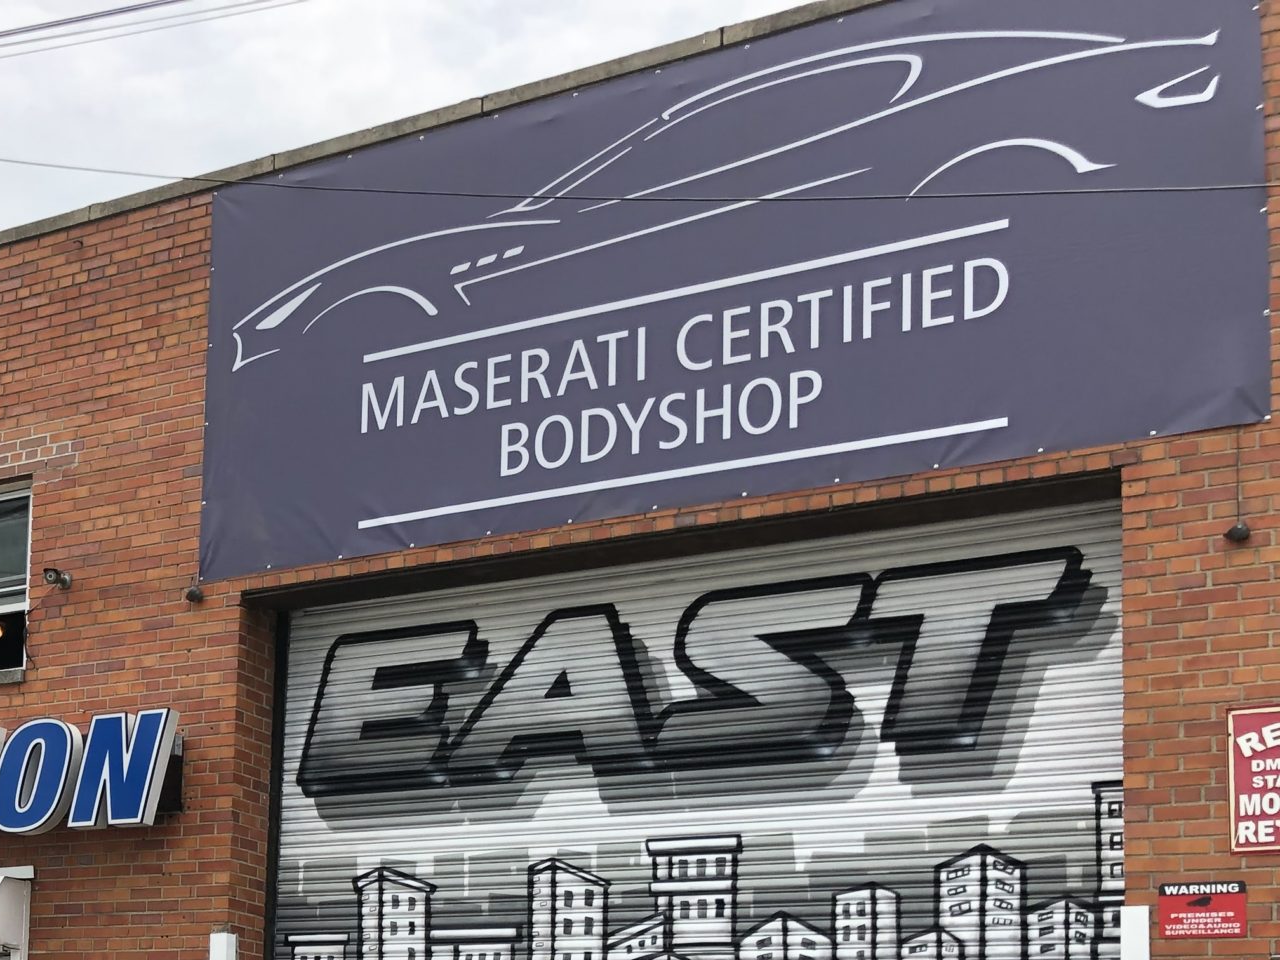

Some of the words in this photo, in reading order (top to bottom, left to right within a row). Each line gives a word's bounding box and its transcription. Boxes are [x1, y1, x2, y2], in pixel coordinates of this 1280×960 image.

[360, 326, 646, 433] MASERATI
[676, 257, 1010, 371] CERTIFIED
[499, 370, 823, 477] BODYSHOP
[296, 545, 1093, 798] EAST
[1164, 883, 1240, 896] WARNING
[1170, 911, 1235, 919] PREMISES
